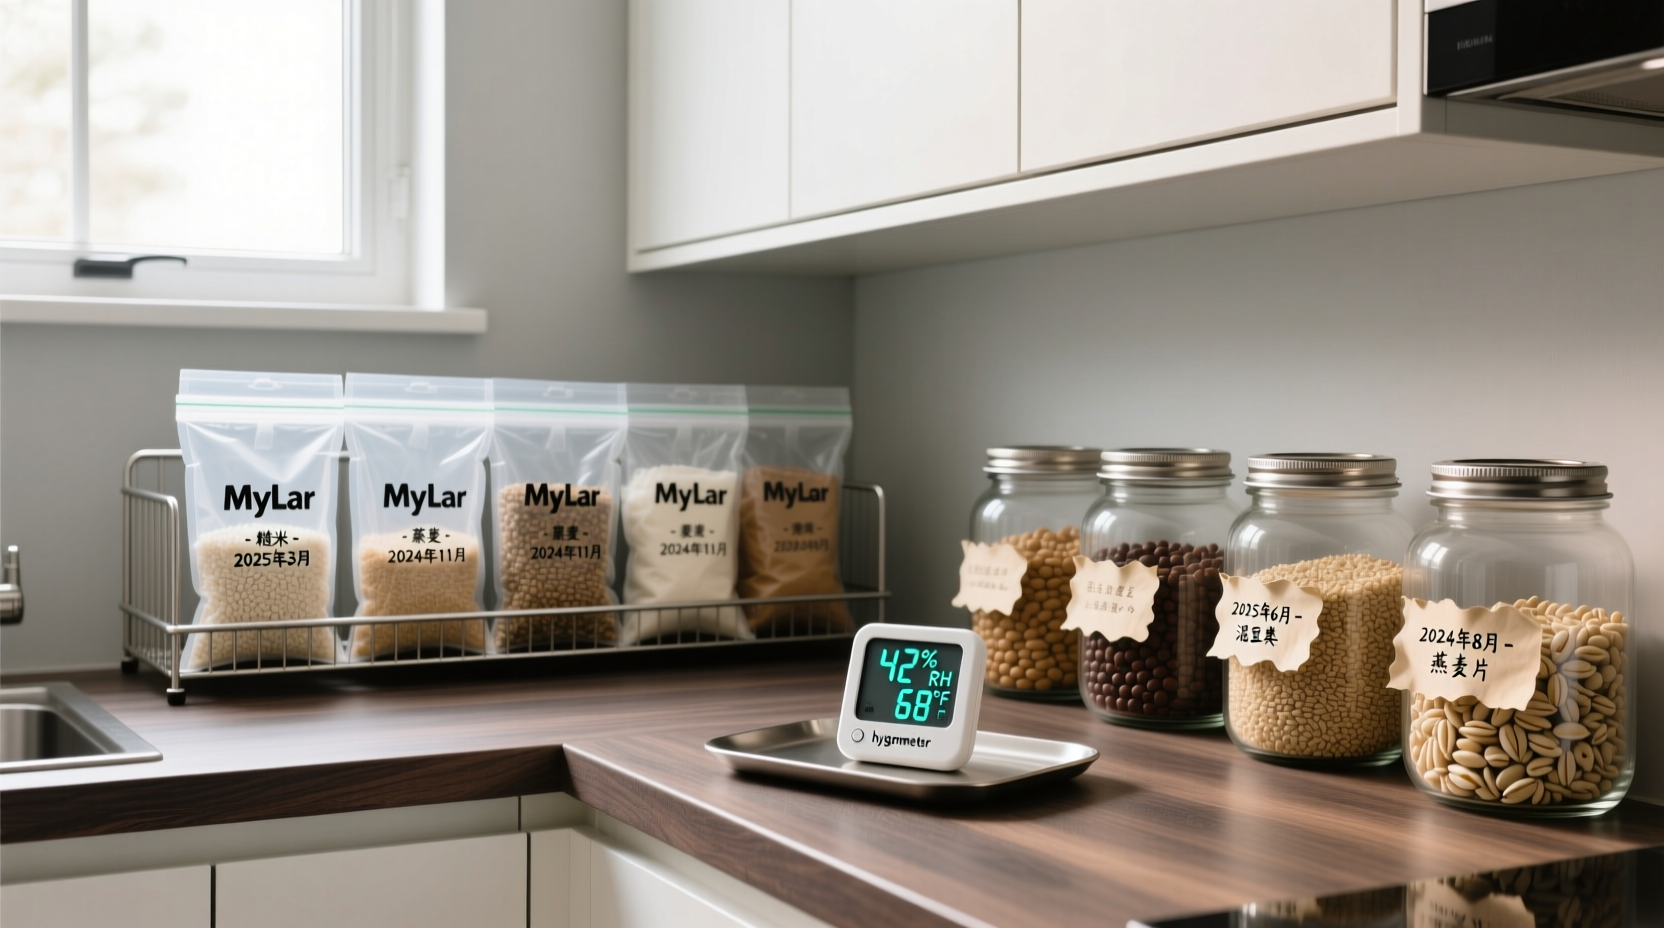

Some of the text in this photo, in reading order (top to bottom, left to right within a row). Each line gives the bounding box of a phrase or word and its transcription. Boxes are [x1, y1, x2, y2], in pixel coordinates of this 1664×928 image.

[224, 484, 316, 519] MyLar
[383, 483, 467, 517] MyLar
[524, 483, 600, 514] MyLar
[655, 482, 727, 512] MyLar
[763, 481, 829, 509] MyLar
[234, 549, 310, 568] 2025年3月
[388, 547, 465, 564] 2024年11月
[530, 544, 601, 561] 2024年11月
[660, 542, 727, 557] 2024年11月
[928, 670, 953, 687] RH
[1430, 650, 1488, 682] 燕麦片
